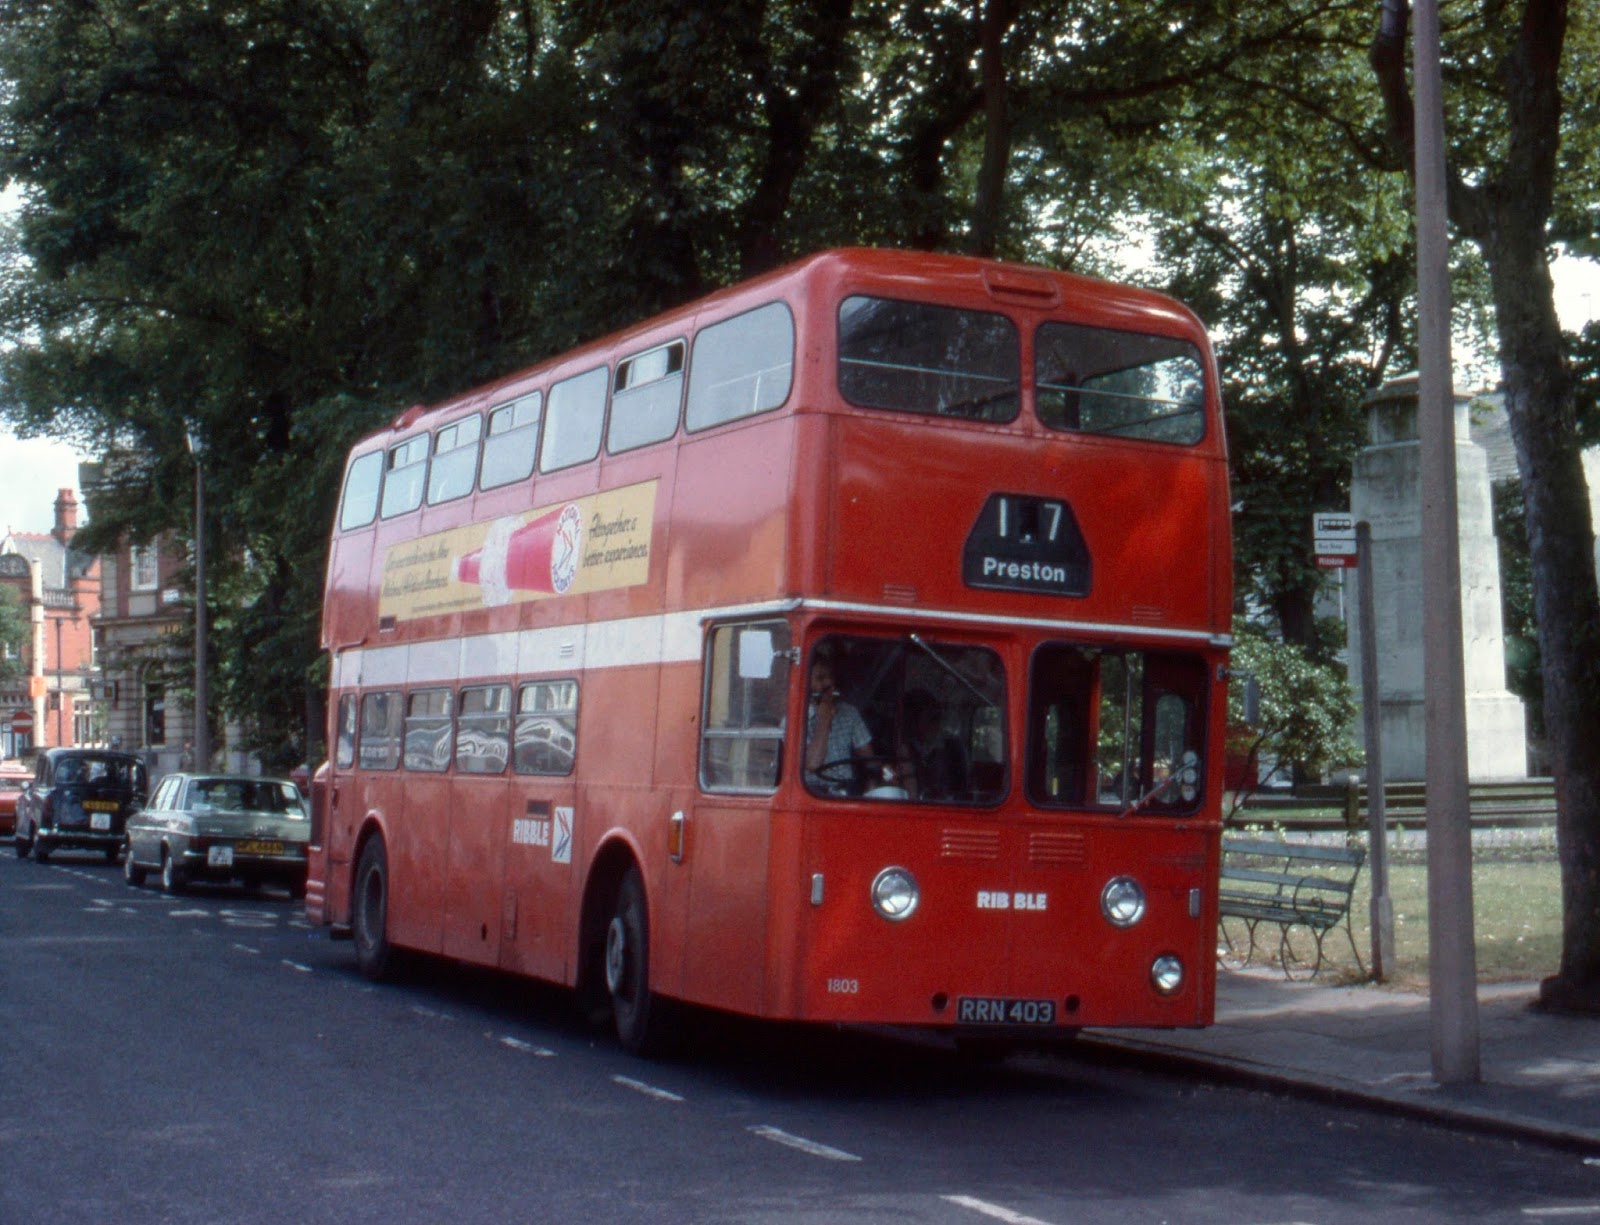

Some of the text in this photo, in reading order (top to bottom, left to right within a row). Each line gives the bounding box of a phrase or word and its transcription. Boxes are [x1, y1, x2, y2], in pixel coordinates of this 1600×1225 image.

[983, 556, 1065, 582] Preston
[512, 818, 549, 846] RIBBLE
[827, 978, 859, 994] 1803
[961, 999, 1051, 1023] RRN 403
